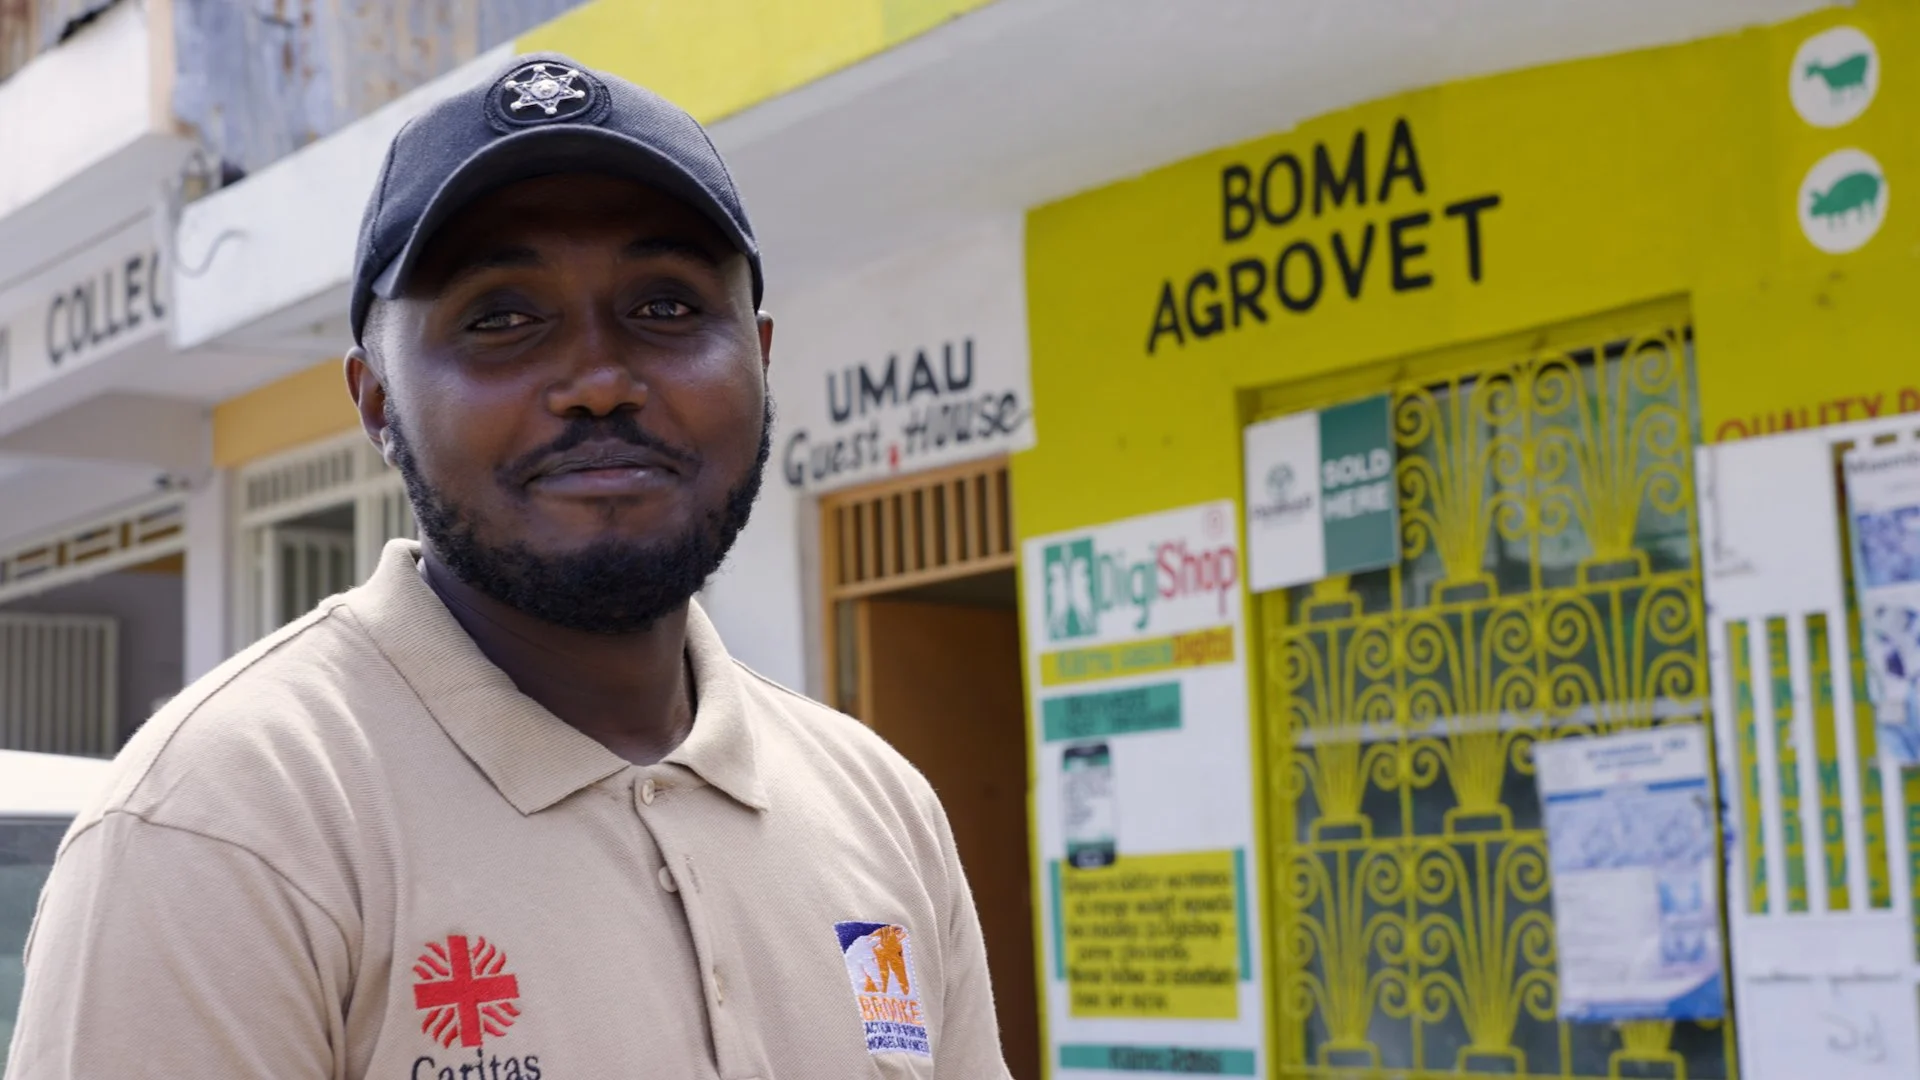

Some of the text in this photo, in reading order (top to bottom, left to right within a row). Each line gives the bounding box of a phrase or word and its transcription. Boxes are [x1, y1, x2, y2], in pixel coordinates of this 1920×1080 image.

[1221, 116, 1426, 243] BOMA
[1147, 194, 1501, 356] AGROVET
[827, 338, 974, 423] UMAU
[783, 427, 881, 487] Guest
[1322, 448, 1391, 490] SOLD
[1324, 481, 1391, 522] HERE
[1093, 541, 1238, 630] DigiShop
[411, 1048, 542, 1080] Caritas
